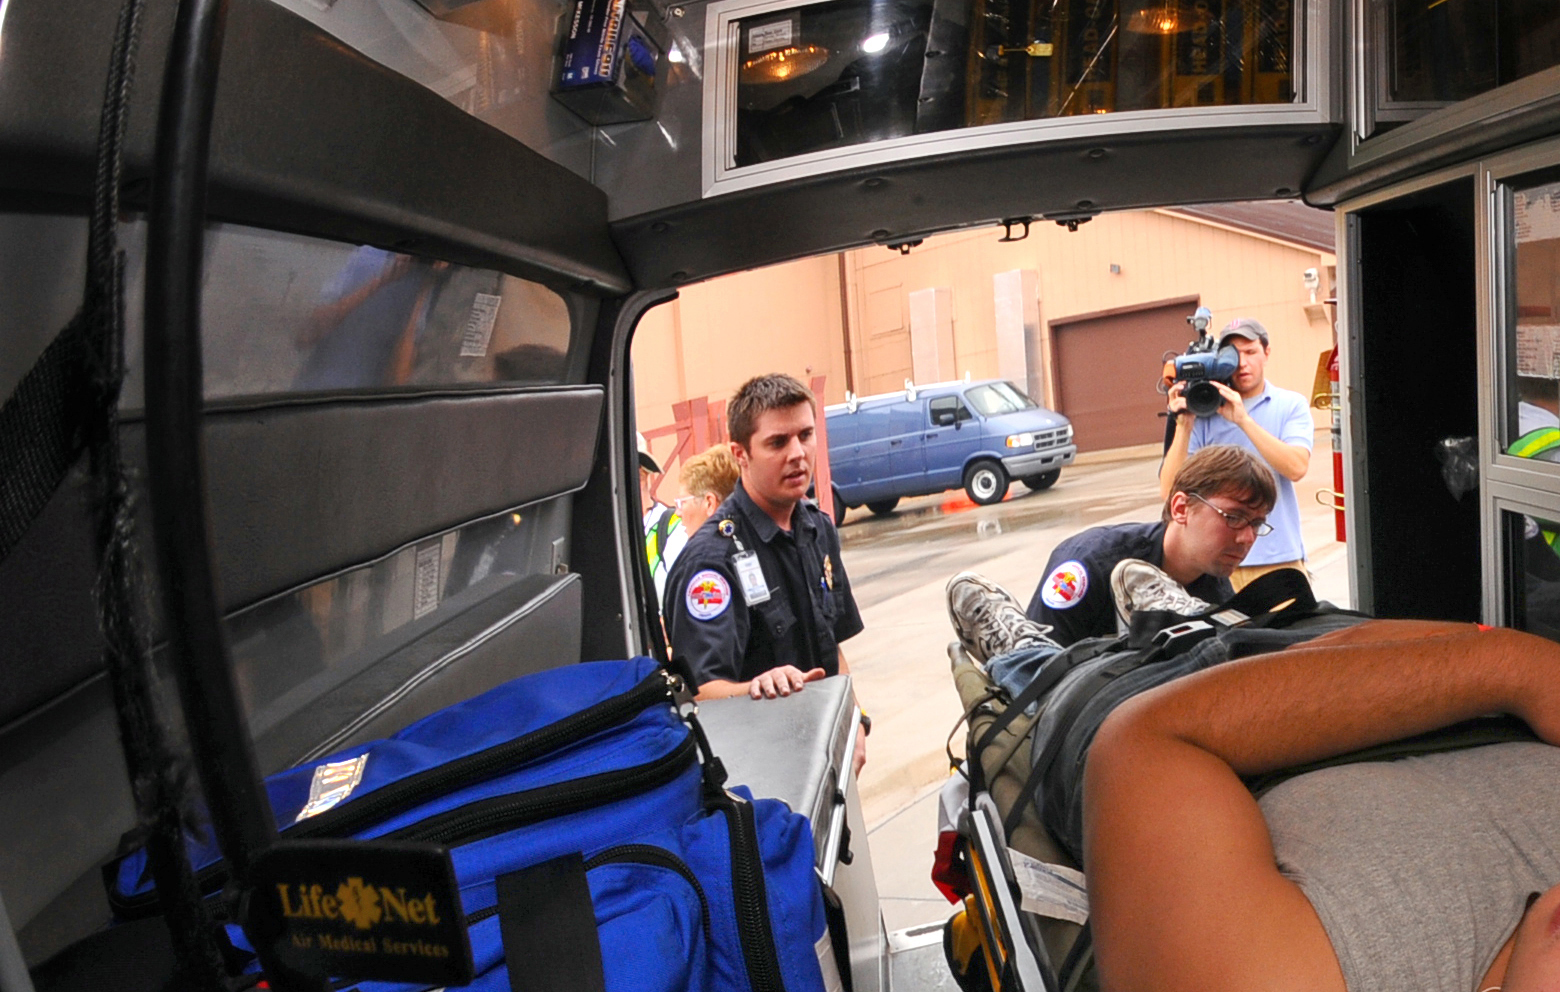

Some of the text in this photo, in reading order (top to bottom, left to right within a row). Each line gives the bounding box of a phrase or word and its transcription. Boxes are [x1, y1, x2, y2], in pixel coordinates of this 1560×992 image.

[276, 883, 440, 925] Life Net
[291, 934, 450, 959] Air Medical Services
